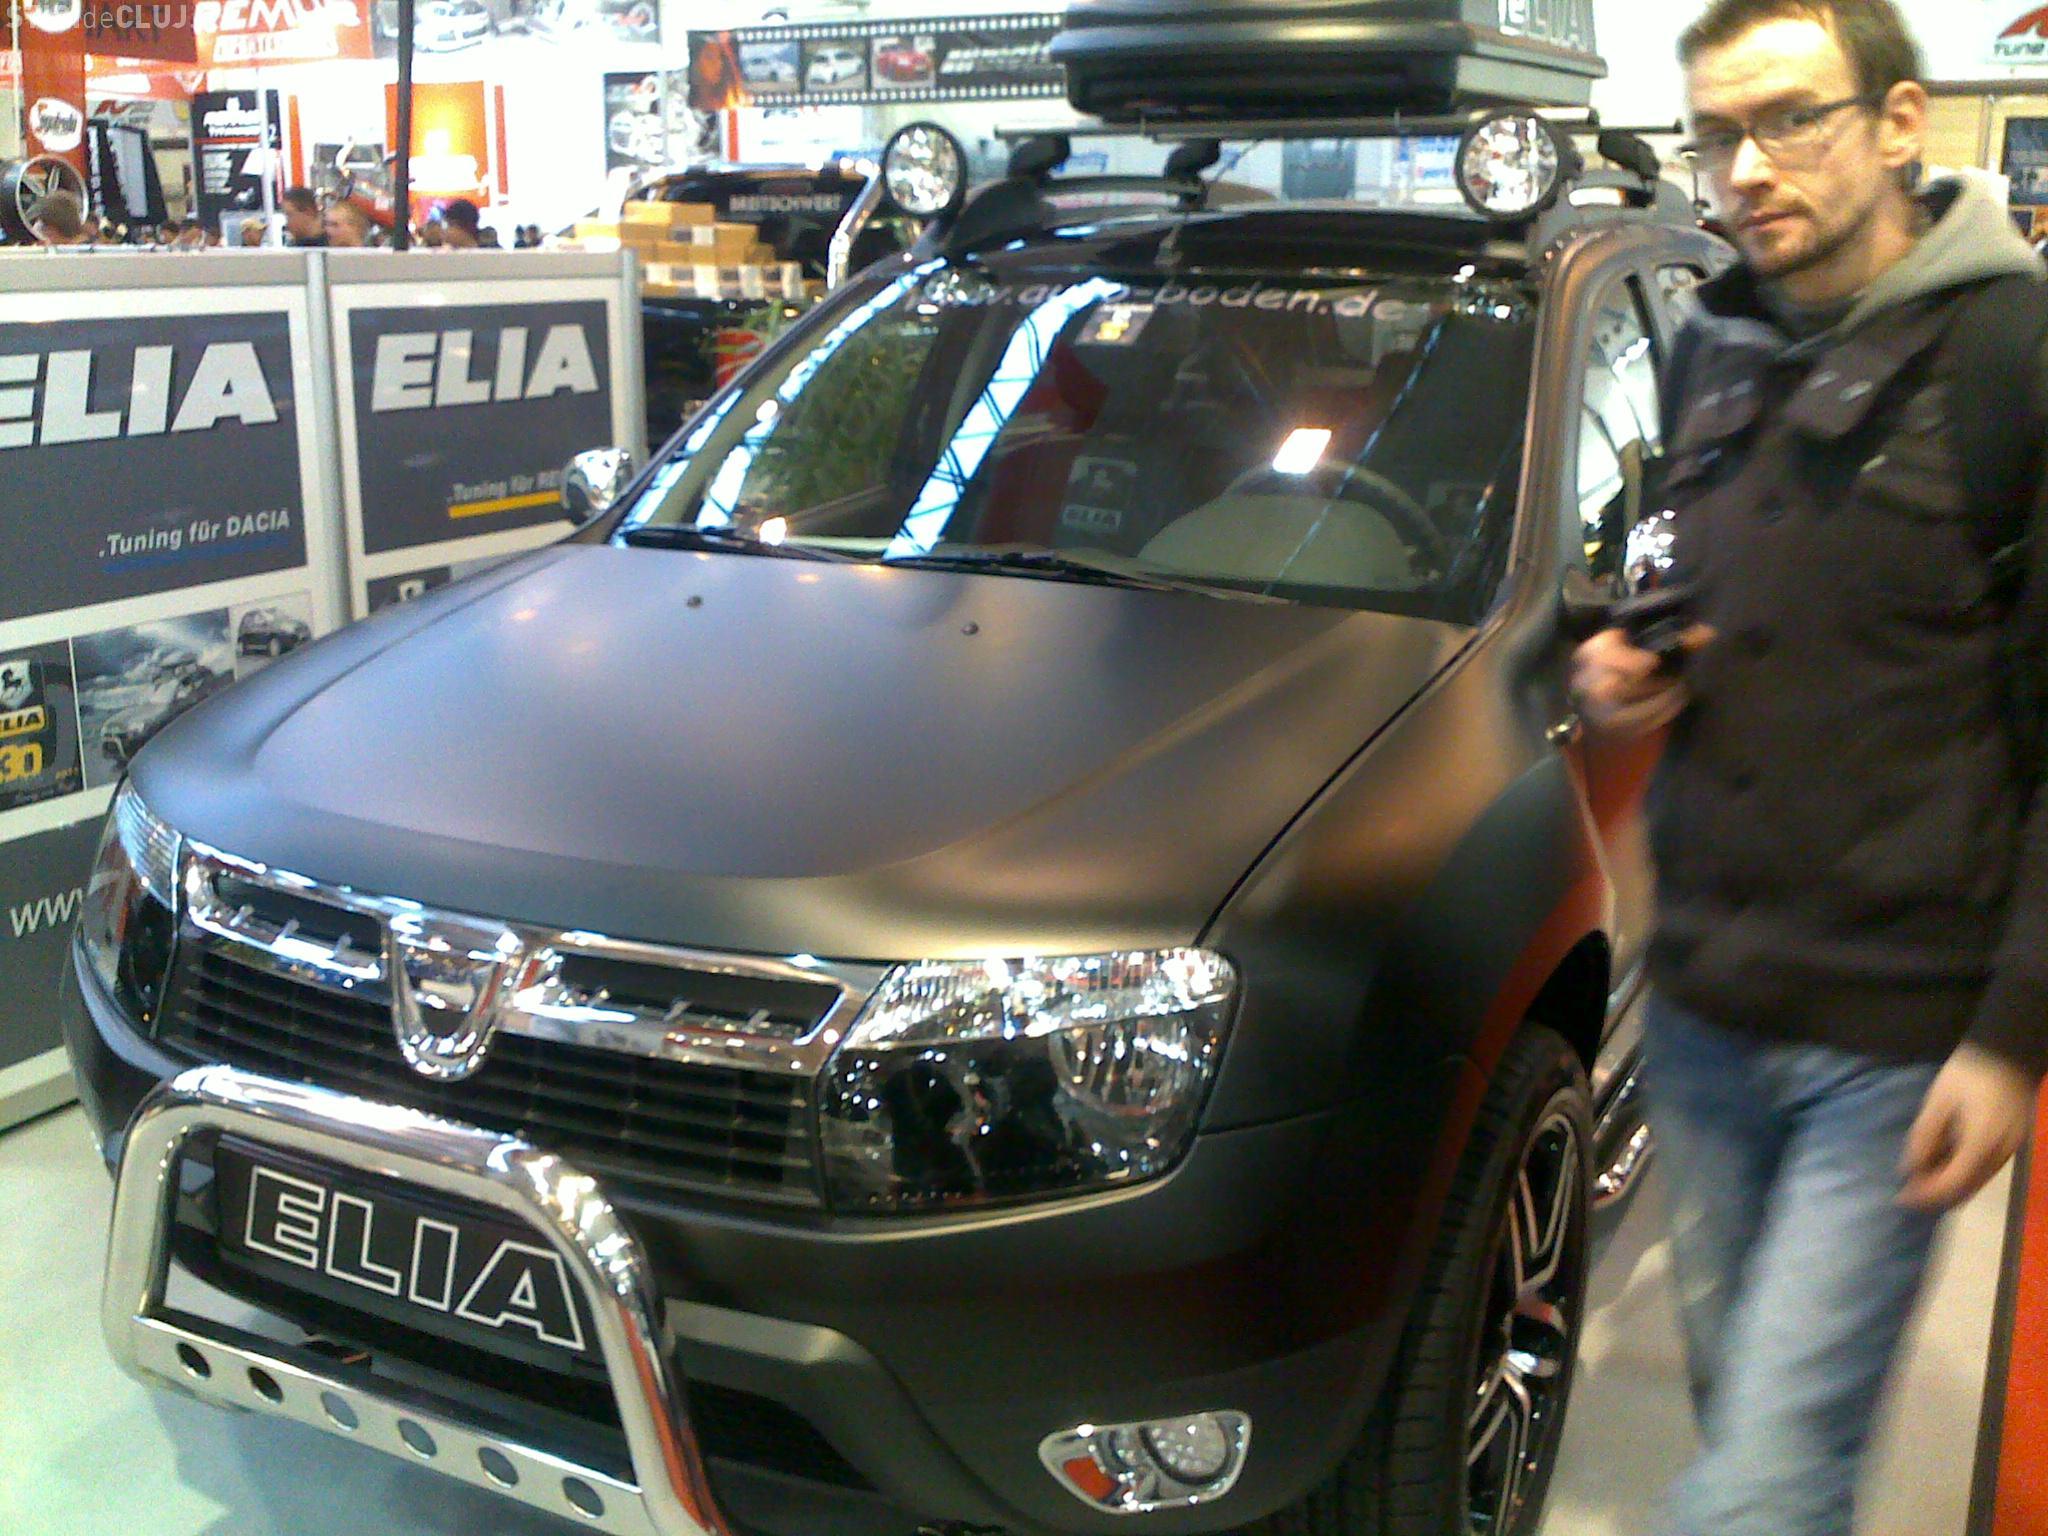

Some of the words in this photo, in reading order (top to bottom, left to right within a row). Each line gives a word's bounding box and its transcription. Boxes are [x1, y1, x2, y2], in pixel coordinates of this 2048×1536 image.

[371, 323, 600, 413] ELIA
[189, 519, 221, 544] für
[226, 507, 290, 537] DACIA
[245, 1165, 585, 1350] ELIA
